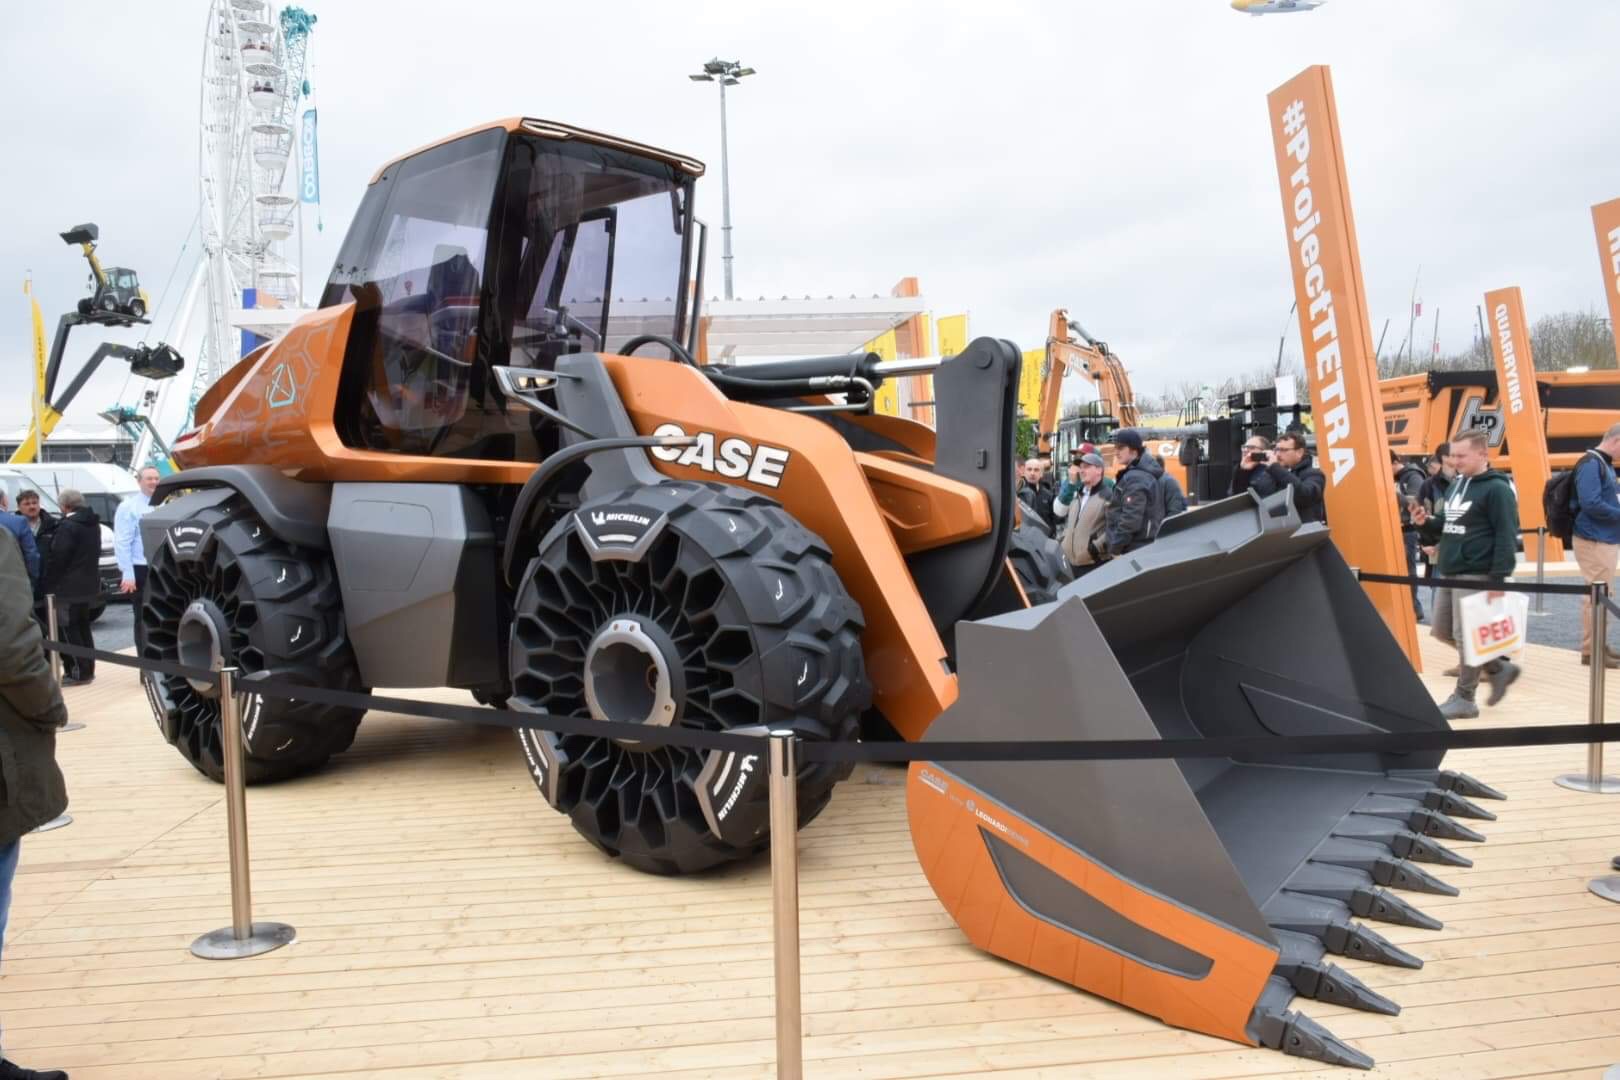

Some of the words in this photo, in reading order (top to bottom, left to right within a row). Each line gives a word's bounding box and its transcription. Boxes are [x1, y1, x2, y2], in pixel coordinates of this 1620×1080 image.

[1282, 99, 1356, 487] #ProjectTETRA
[1495, 303, 1523, 415] QUARRYING
[651, 422, 790, 488] CASE
[606, 513, 650, 526] MICHELIN
[717, 771, 747, 821] MICHELIN
